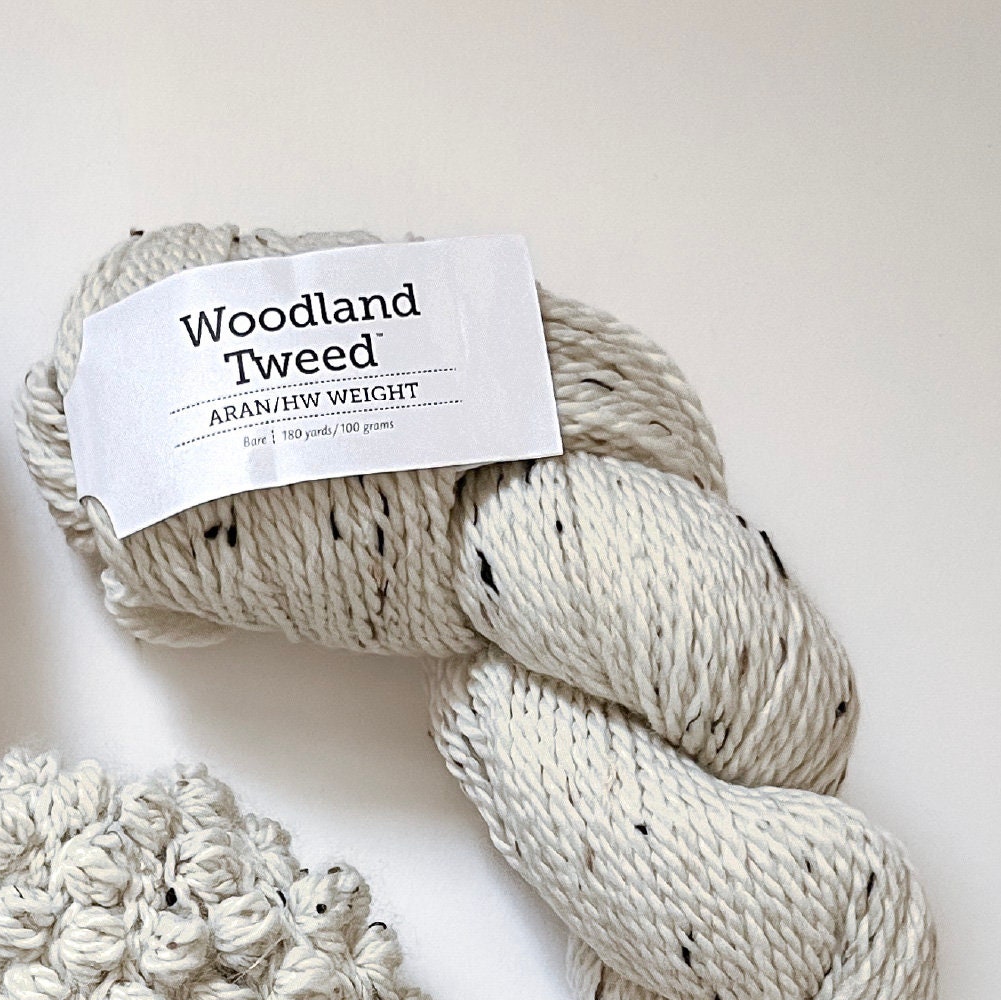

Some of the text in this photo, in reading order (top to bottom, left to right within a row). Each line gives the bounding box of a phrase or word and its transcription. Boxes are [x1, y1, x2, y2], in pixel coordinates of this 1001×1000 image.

[179, 283, 421, 347] Woodland
[208, 381, 420, 427] ARAN/HW WEIGHT
[281, 428, 303, 441] 180
[363, 420, 395, 434] grams
